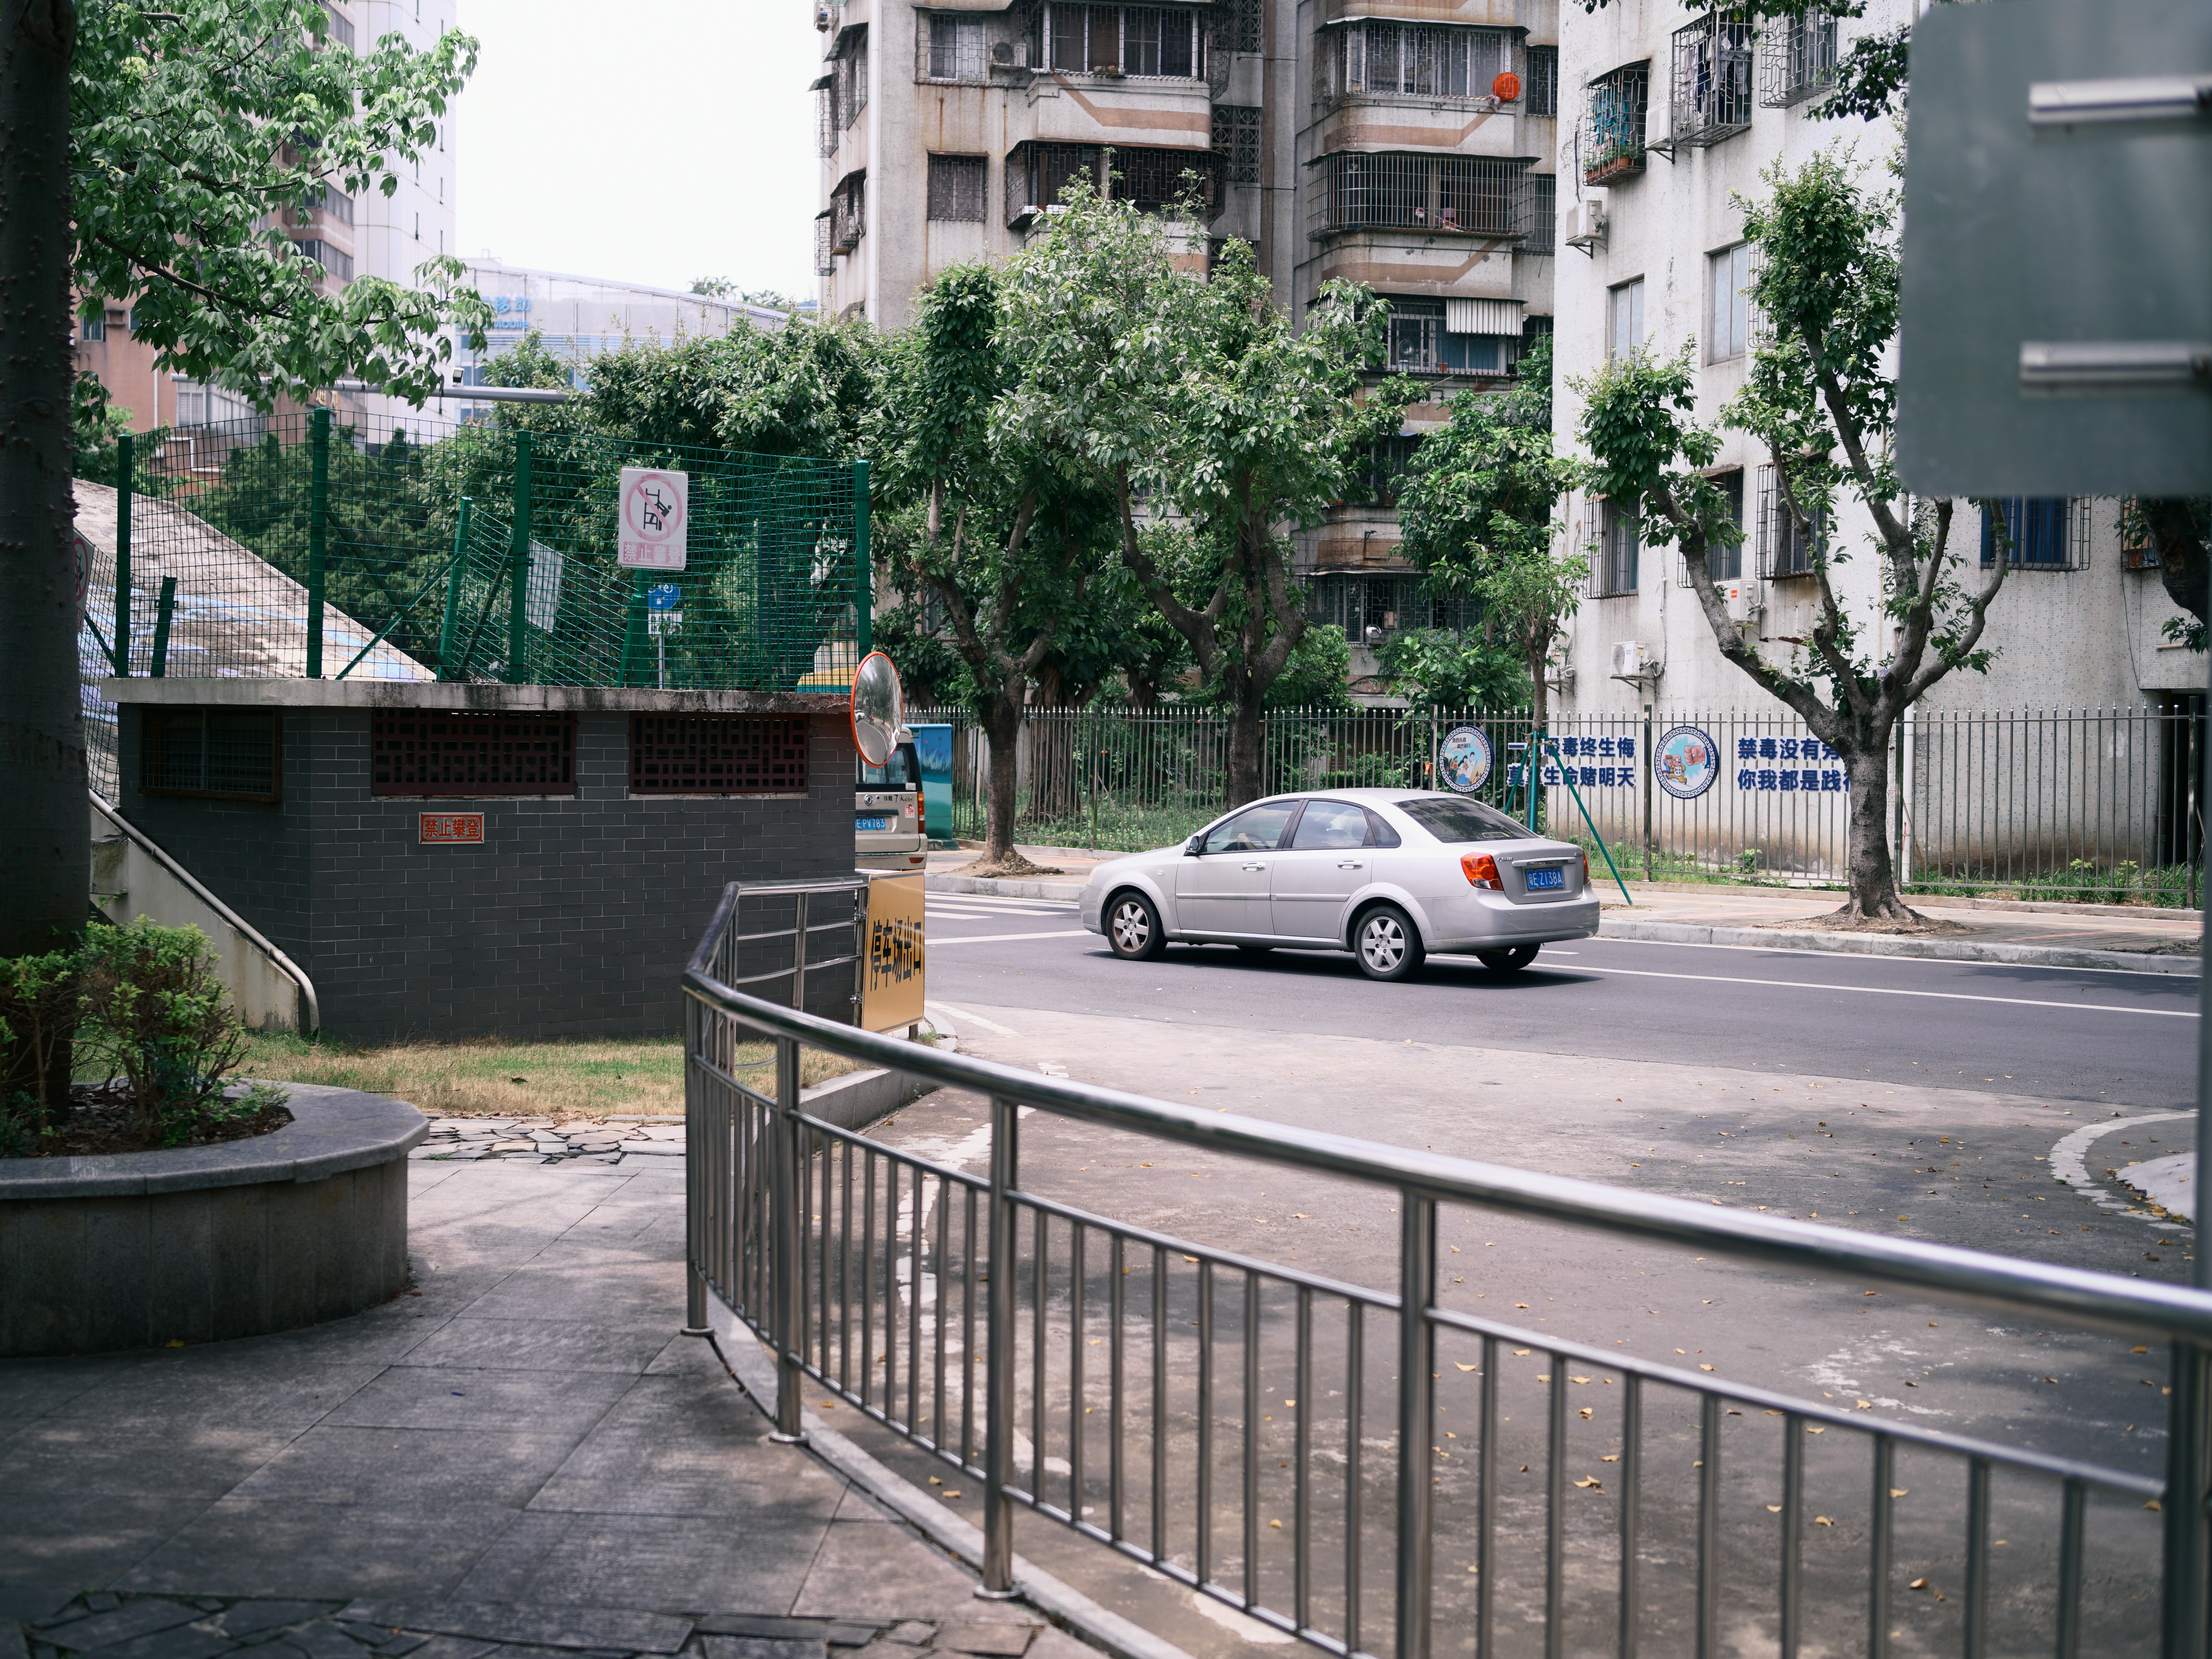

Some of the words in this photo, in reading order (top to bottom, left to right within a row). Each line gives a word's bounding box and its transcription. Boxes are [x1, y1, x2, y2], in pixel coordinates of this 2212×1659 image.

[624, 543, 681, 564] 禁止攀登
[1508, 736, 1635, 758] 一吸毒终生悔
[425, 818, 479, 837] 禁止攀登
[870, 915, 922, 992] 停车场出口
